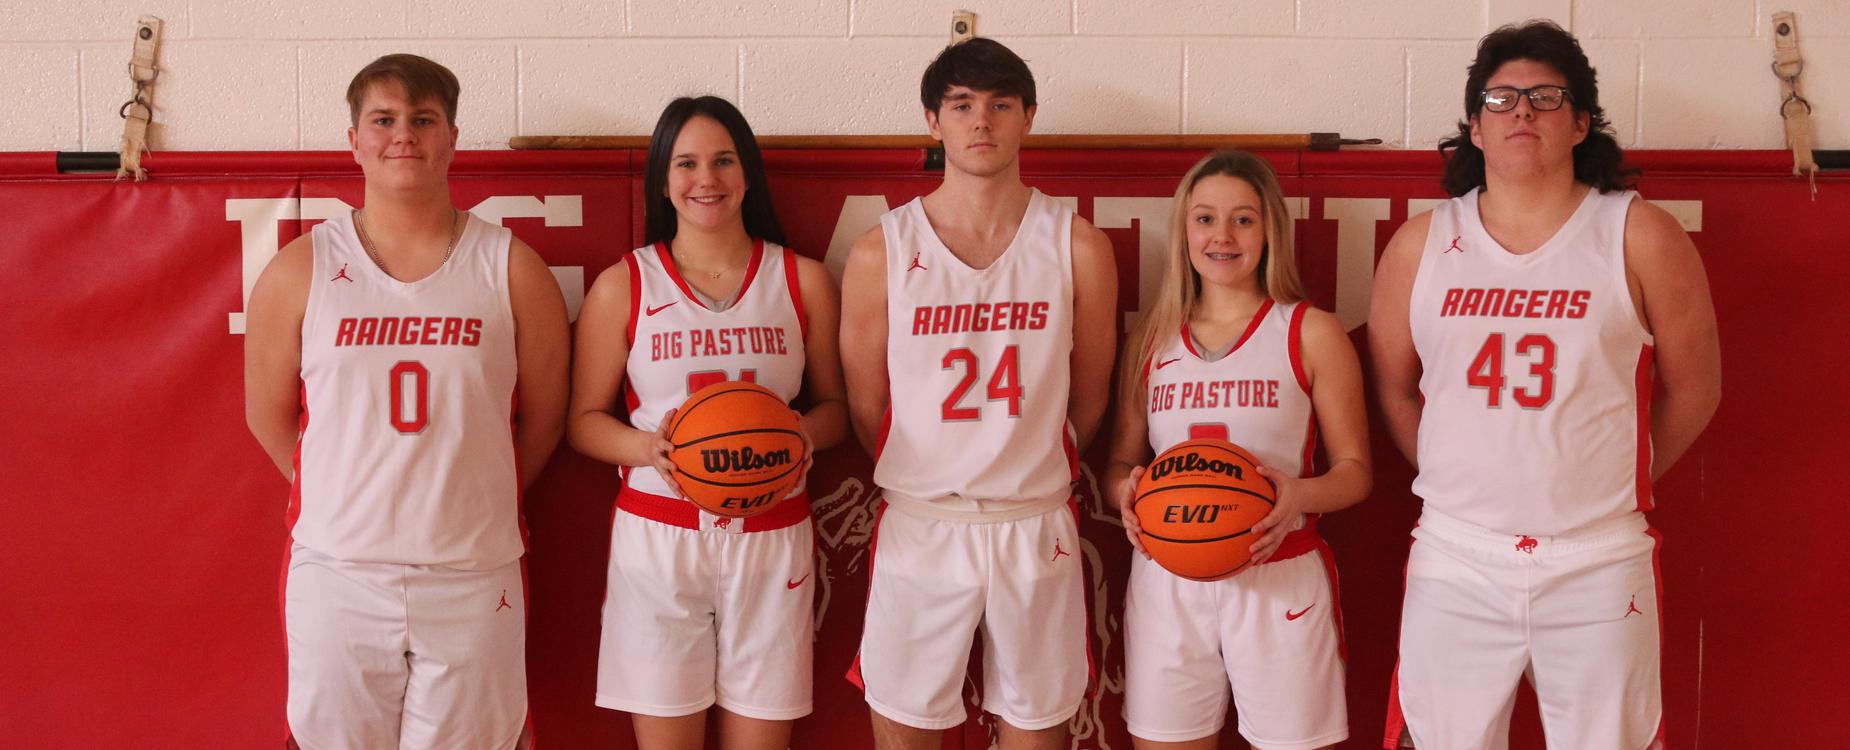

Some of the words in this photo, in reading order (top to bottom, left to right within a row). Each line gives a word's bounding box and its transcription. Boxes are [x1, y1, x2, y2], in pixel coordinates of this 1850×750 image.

[912, 301, 1049, 336] RANGERS
[1439, 288, 1591, 320] RANGERS
[335, 316, 484, 348] RANGERS
[651, 331, 683, 362] BIG
[690, 326, 788, 358] PASTURE
[941, 345, 1026, 423] 24
[1467, 332, 1558, 411] 43
[388, 360, 433, 436] 0
[1151, 383, 1177, 414] BIG
[1180, 379, 1280, 409] PASTURE
[701, 446, 791, 473] Wilson
[1151, 452, 1243, 481] Wilson
[1163, 504, 1220, 523] EVO
[1221, 504, 1239, 512] NXT
